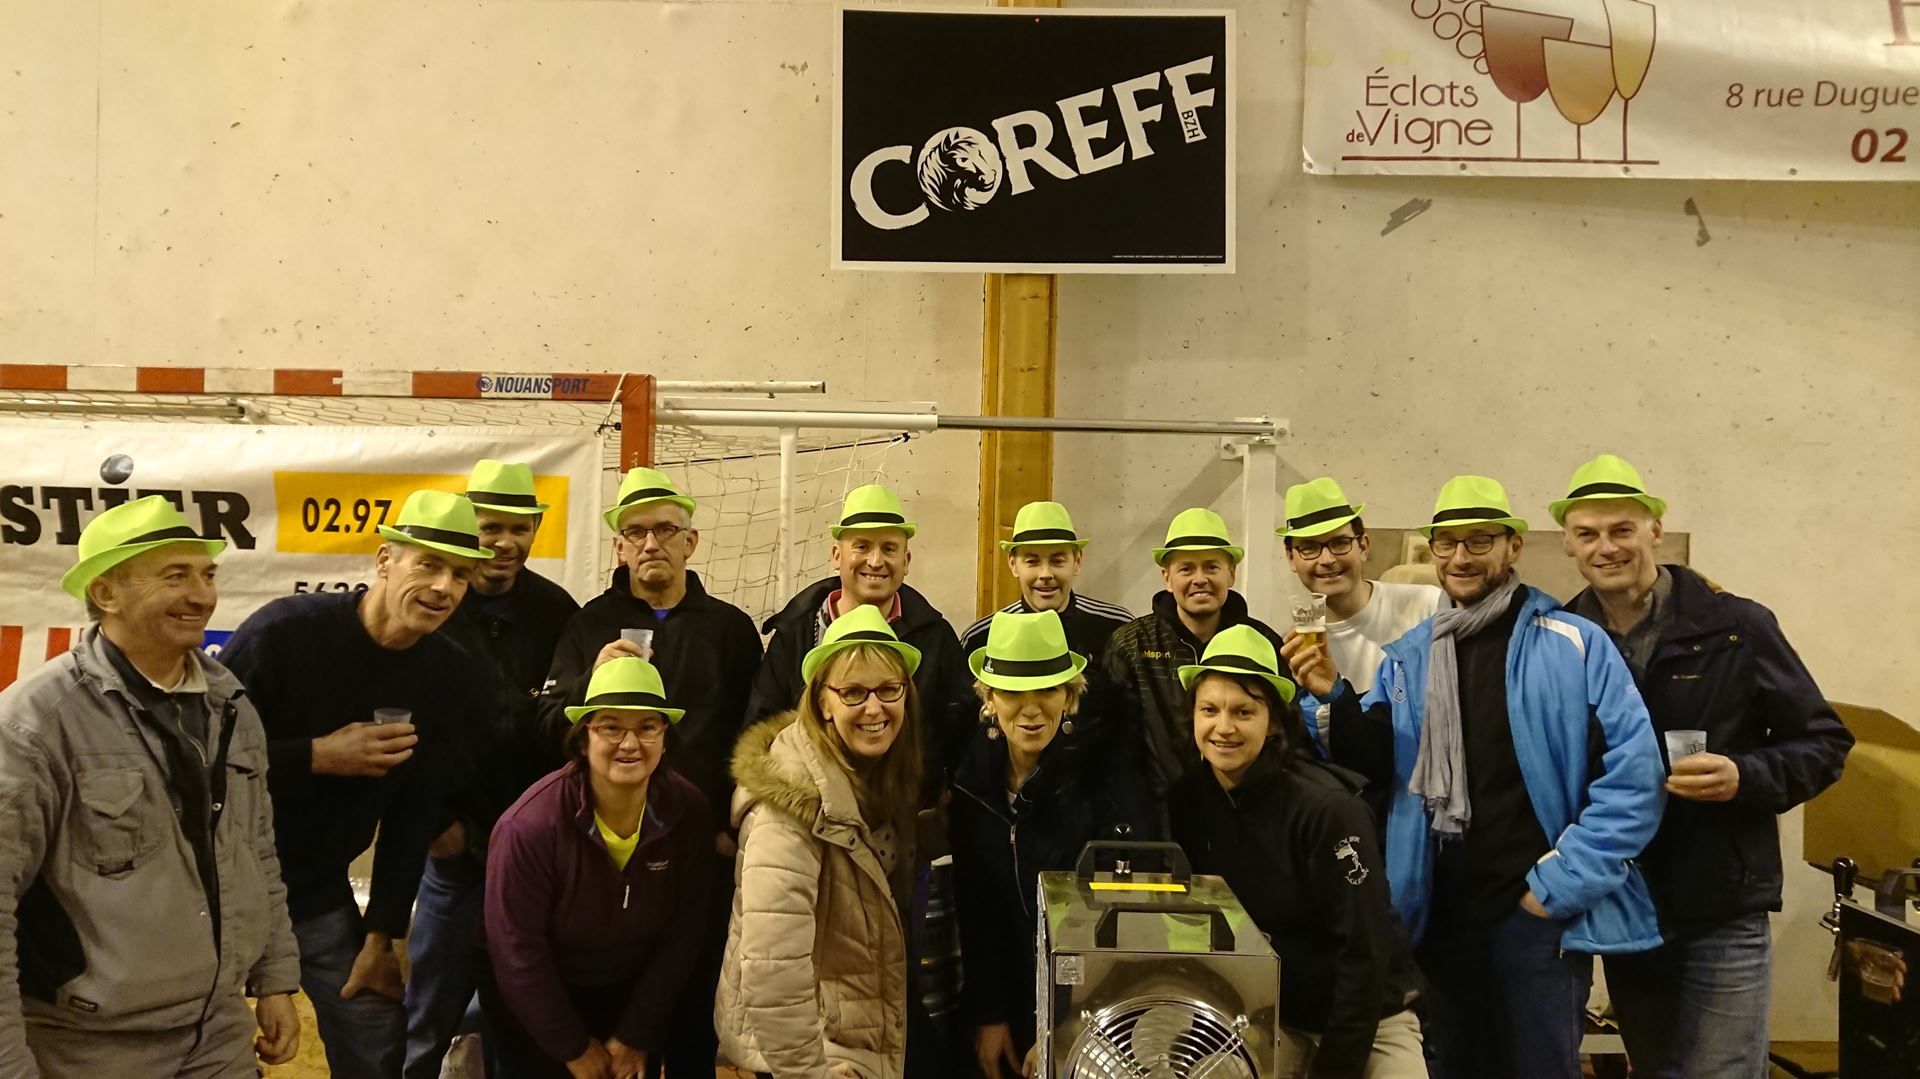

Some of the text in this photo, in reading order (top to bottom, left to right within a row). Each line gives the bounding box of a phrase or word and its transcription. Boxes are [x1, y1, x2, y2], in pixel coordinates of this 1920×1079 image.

[1365, 66, 1479, 108] Éclats
[1726, 80, 1920, 114] 8 rue Dugue
[849, 54, 1216, 231] COREFF
[1181, 109, 1201, 140] BZH
[1355, 107, 1494, 154] Vigne
[1851, 127, 1909, 164] 02
[494, 376, 591, 395] NOUANSPORT
[302, 497, 392, 534] 02.97
